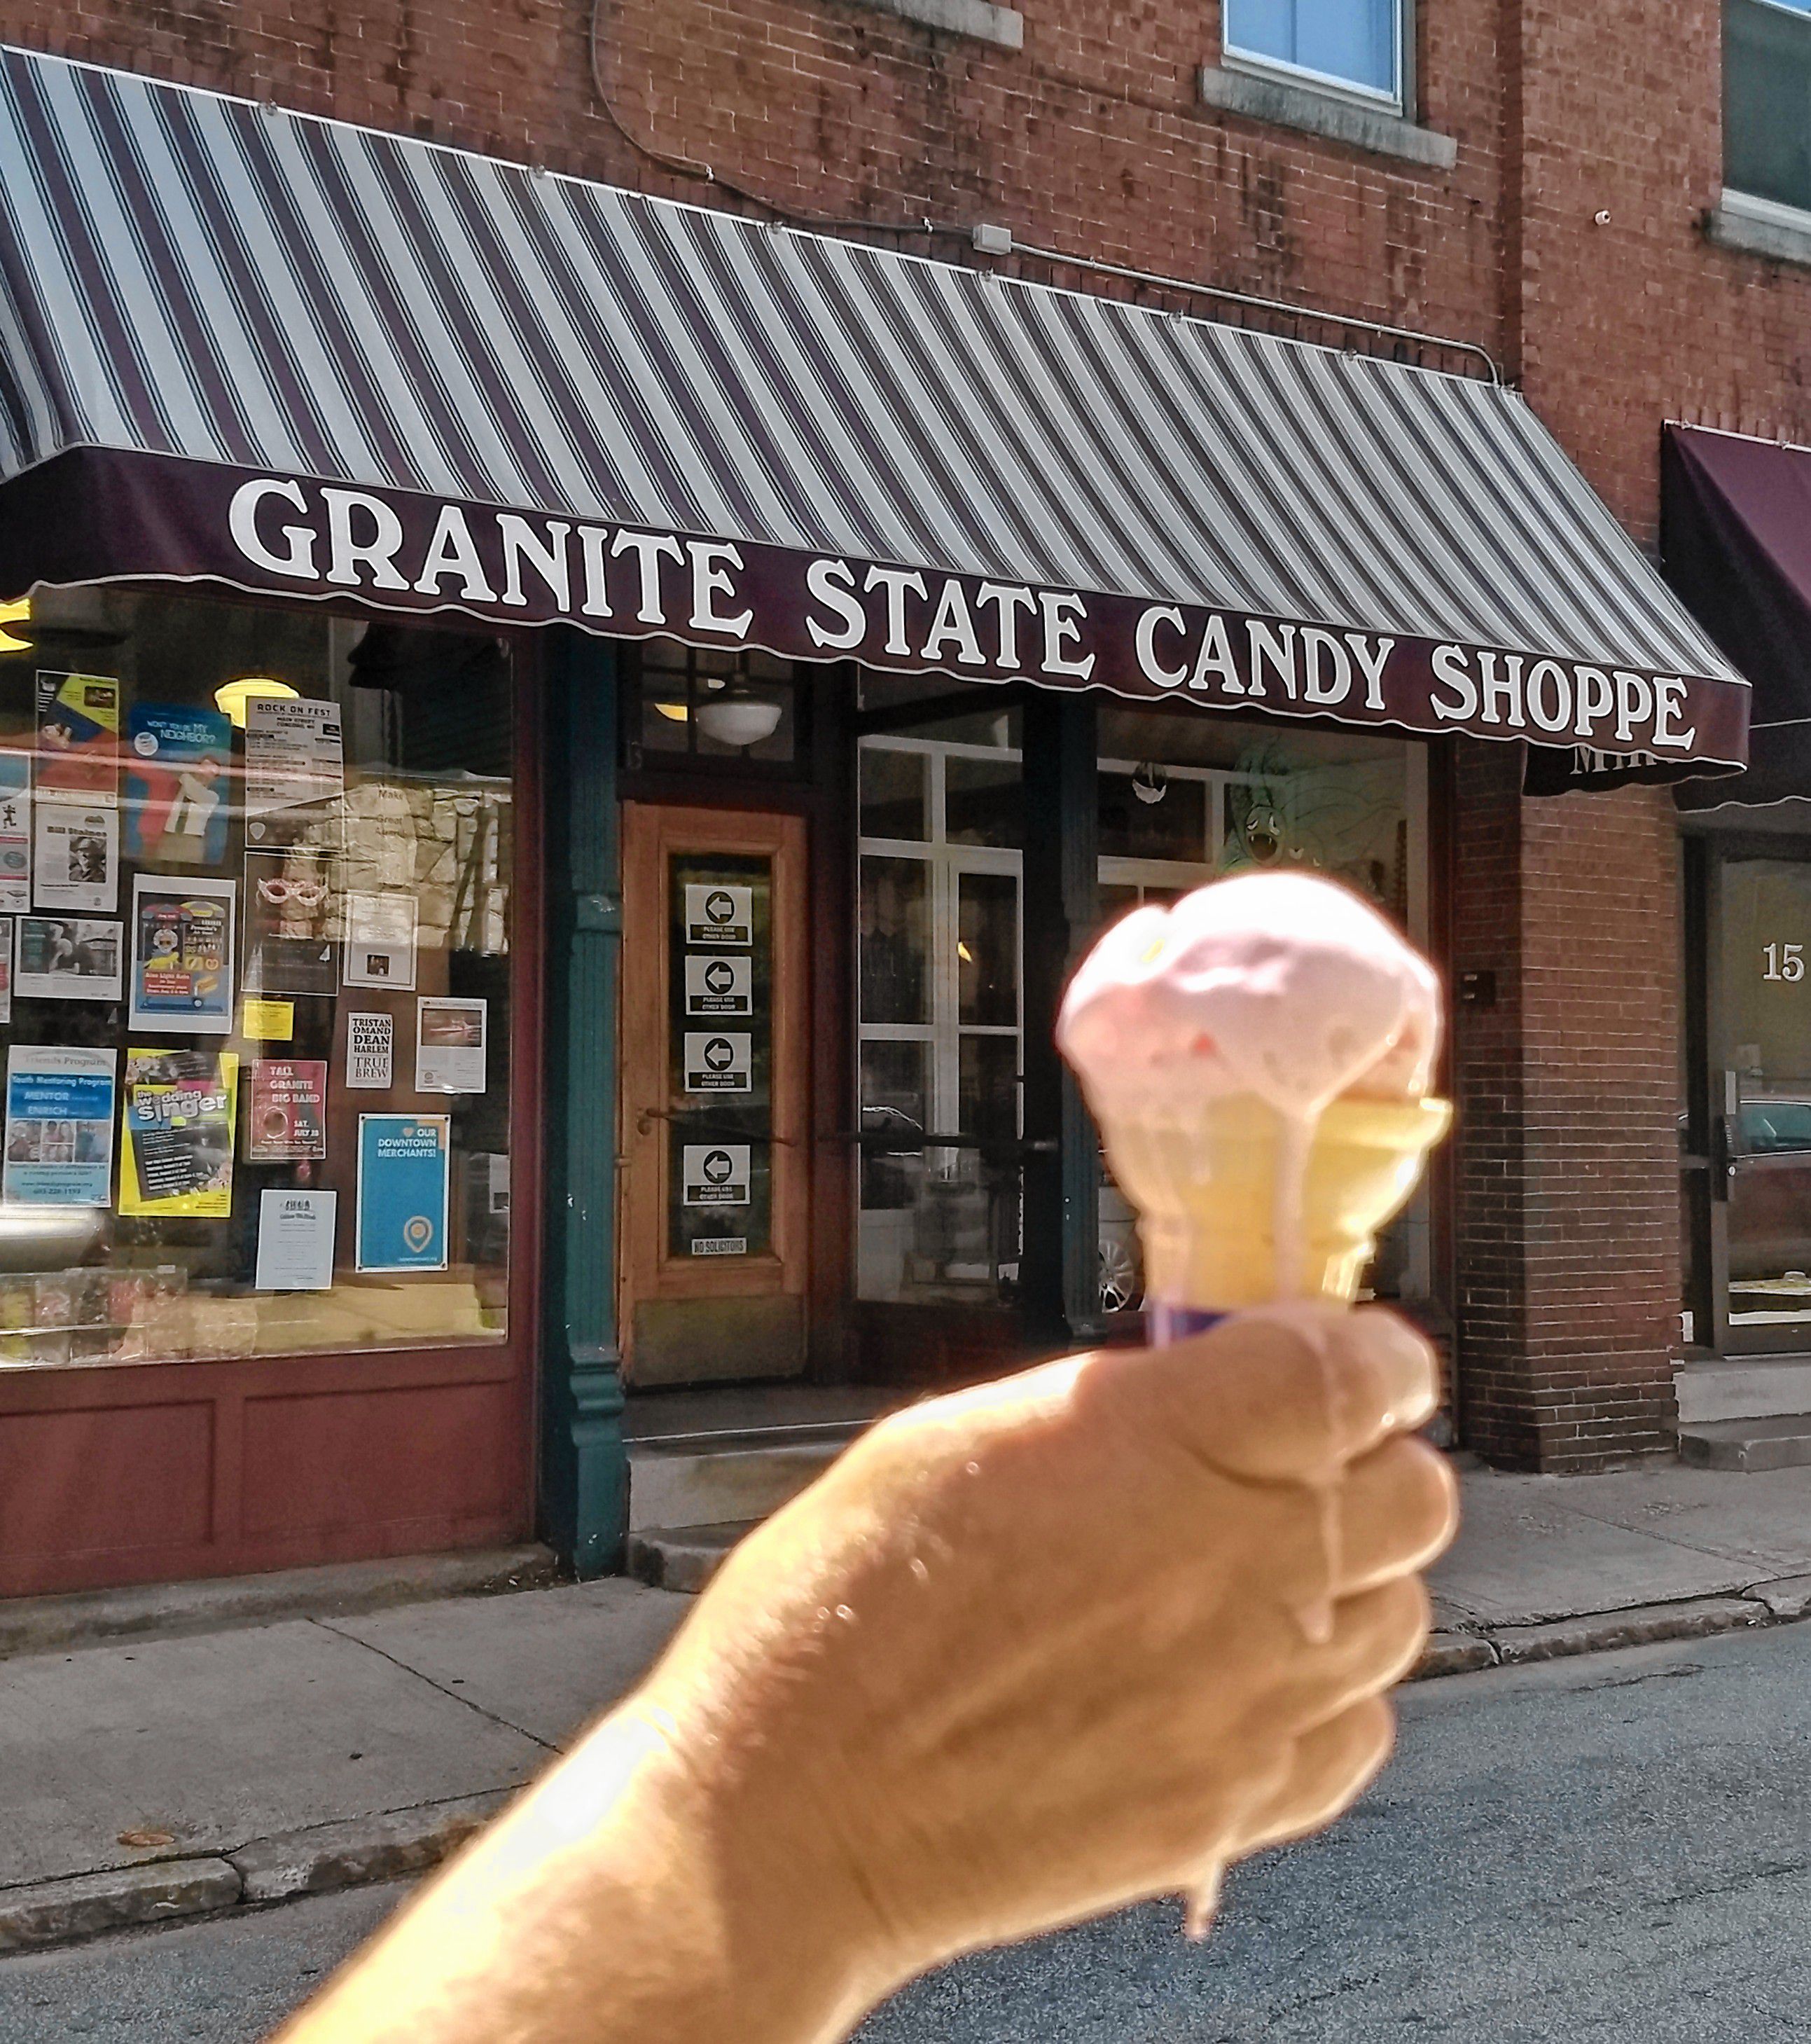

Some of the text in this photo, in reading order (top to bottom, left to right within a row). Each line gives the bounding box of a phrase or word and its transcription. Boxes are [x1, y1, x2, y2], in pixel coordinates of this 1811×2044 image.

[229, 478, 1697, 750] GRANITE STATE CANDY SHOPPE
[257, 703, 331, 717] ROCK ON FEST
[1763, 941, 1805, 981] 15
[352, 1018, 391, 1028] TRISTAN
[353, 1026, 391, 1035] OMAND
[354, 1035, 390, 1045] DEAN
[354, 1044, 389, 1054] HARLEM
[64, 1056, 106, 1067] Program
[354, 1056, 389, 1068] TRUE
[269, 1066, 293, 1076] TALL
[356, 1068, 389, 1079] BREW
[270, 1079, 314, 1090] GRANITE
[24, 1091, 70, 1101] MENTOR
[138, 1090, 202, 1106] wedding
[272, 1093, 320, 1103] BIG BAND
[138, 1094, 227, 1126] singer
[417, 1128, 437, 1138] OUR
[378, 1138, 437, 1147] DOWNTOWN
[378, 1148, 436, 1158] MERCHANTS!
[695, 1240, 744, 1252] NO SOLICITORS
